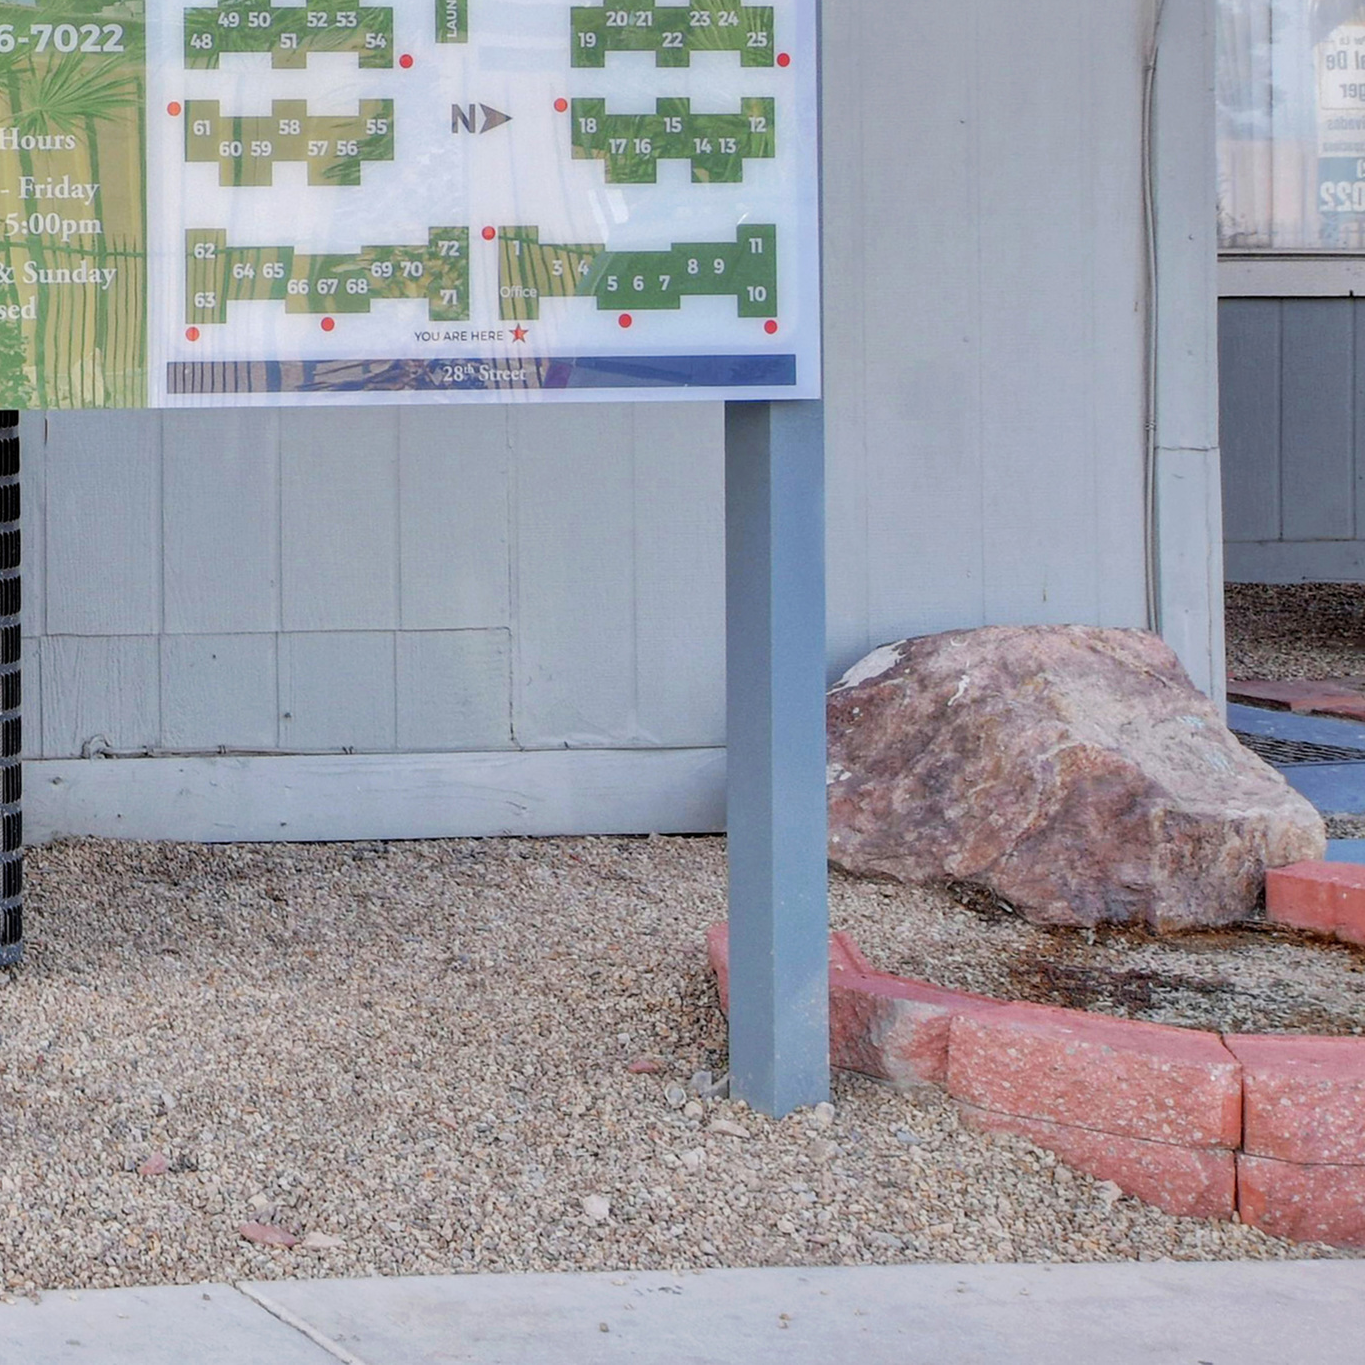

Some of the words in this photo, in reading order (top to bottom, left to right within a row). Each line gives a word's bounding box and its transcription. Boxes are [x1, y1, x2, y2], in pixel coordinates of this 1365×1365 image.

[218, 12, 240, 27] 49
[248, 12, 271, 28] 50
[307, 12, 328, 28] 52
[336, 12, 357, 27] 53
[606, 11, 628, 26] 20
[636, 11, 652, 26] 21
[690, 11, 710, 26] 23
[718, 11, 739, 26] 24
[190, 33, 213, 49] 48
[280, 33, 297, 48] 51
[365, 33, 387, 48] 54
[578, 33, 596, 48] 19
[662, 32, 683, 47] 22
[747, 32, 767, 47] 25
[451, 103, 476, 133] N
[579, 118, 597, 133] 18
[664, 117, 681, 133] 15
[749, 117, 767, 132] 12
[193, 120, 211, 135] 61
[279, 119, 300, 135] 58
[366, 119, 387, 134] 55
[220, 141, 242, 157] 60
[251, 141, 272, 156] 59
[308, 141, 328, 156] 57
[336, 141, 358, 156] 56
[609, 138, 627, 154] 17
[633, 138, 651, 153] 16
[694, 138, 712, 153] 14
[719, 138, 736, 153] 13
[18, 176, 100, 205] Friday
[4, 212, 102, 242] 5:00pm
[194, 243, 216, 259] 62
[438, 241, 459, 256] 72
[749, 238, 762, 253] 11
[233, 263, 254, 279] 64
[263, 263, 284, 279] 65
[371, 262, 392, 277] 69
[400, 261, 423, 277] 70
[552, 260, 563, 276] 3
[578, 260, 589, 276] 4
[687, 259, 699, 274] 8
[713, 258, 725, 274] 9
[23, 260, 117, 289] Sunday
[287, 279, 309, 294] 66
[317, 279, 338, 294] 67
[346, 278, 368, 294] 68
[607, 276, 618, 291] 5
[633, 276, 644, 291] 6
[659, 276, 671, 291] 7
[194, 292, 216, 308] 63
[440, 289, 458, 305] 71
[500, 286, 537, 298] Office
[747, 286, 766, 301] 10
[414, 332, 440, 342] YOU
[443, 331, 467, 341] ARE
[471, 331, 503, 341] HERE
[478, 365, 526, 381] Street
